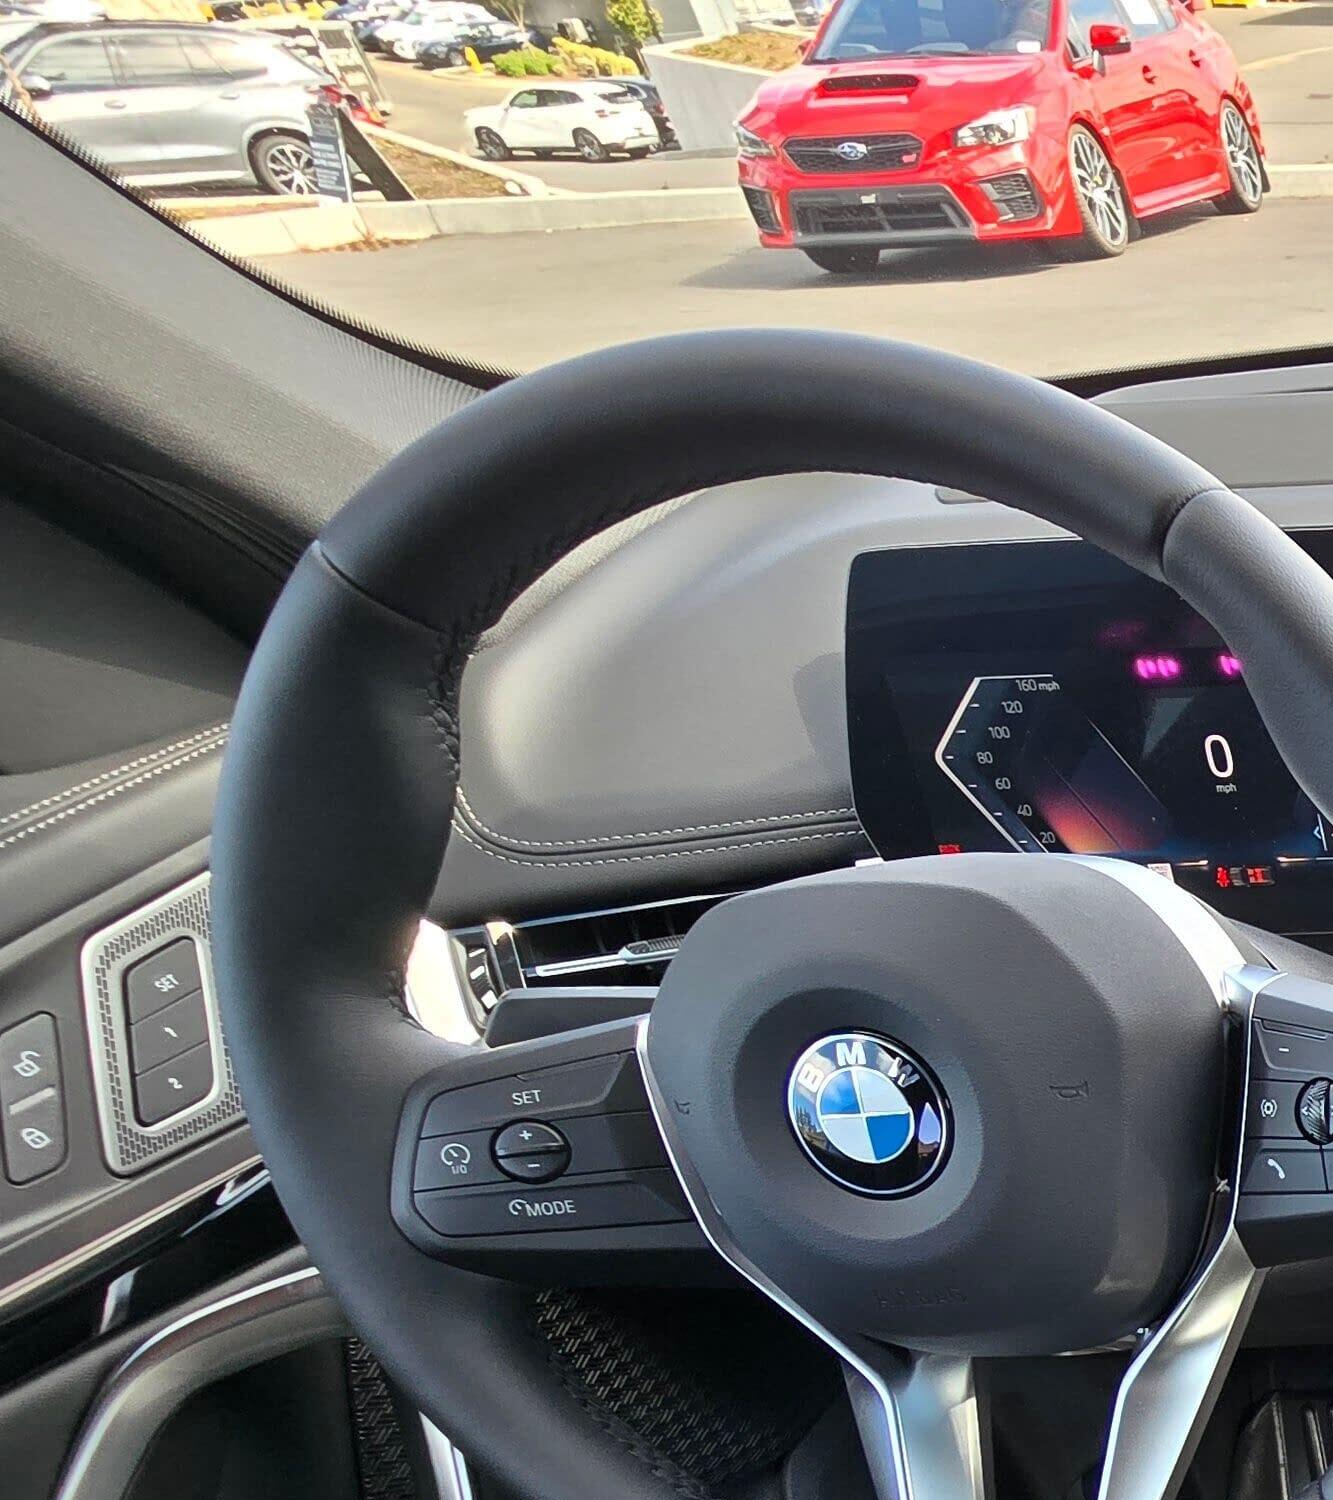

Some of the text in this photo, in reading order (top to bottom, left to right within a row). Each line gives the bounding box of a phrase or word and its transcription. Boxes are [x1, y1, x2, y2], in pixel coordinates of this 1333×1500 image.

[1016, 679, 1060, 692] 160 mph
[1001, 701, 1023, 714] 120
[988, 726, 1011, 739] 100
[976, 751, 993, 764] 80
[1204, 734, 1234, 778] 0
[995, 777, 1011, 790] 60
[1216, 783, 1237, 794] mph
[1017, 804, 1032, 817] 40
[1039, 832, 1056, 844] 20
[154, 973, 179, 992] SET
[798, 1041, 921, 1093] BMW
[168, 1077, 183, 1089] 2
[511, 1089, 542, 1106] SET
[525, 1199, 577, 1217] MODE
